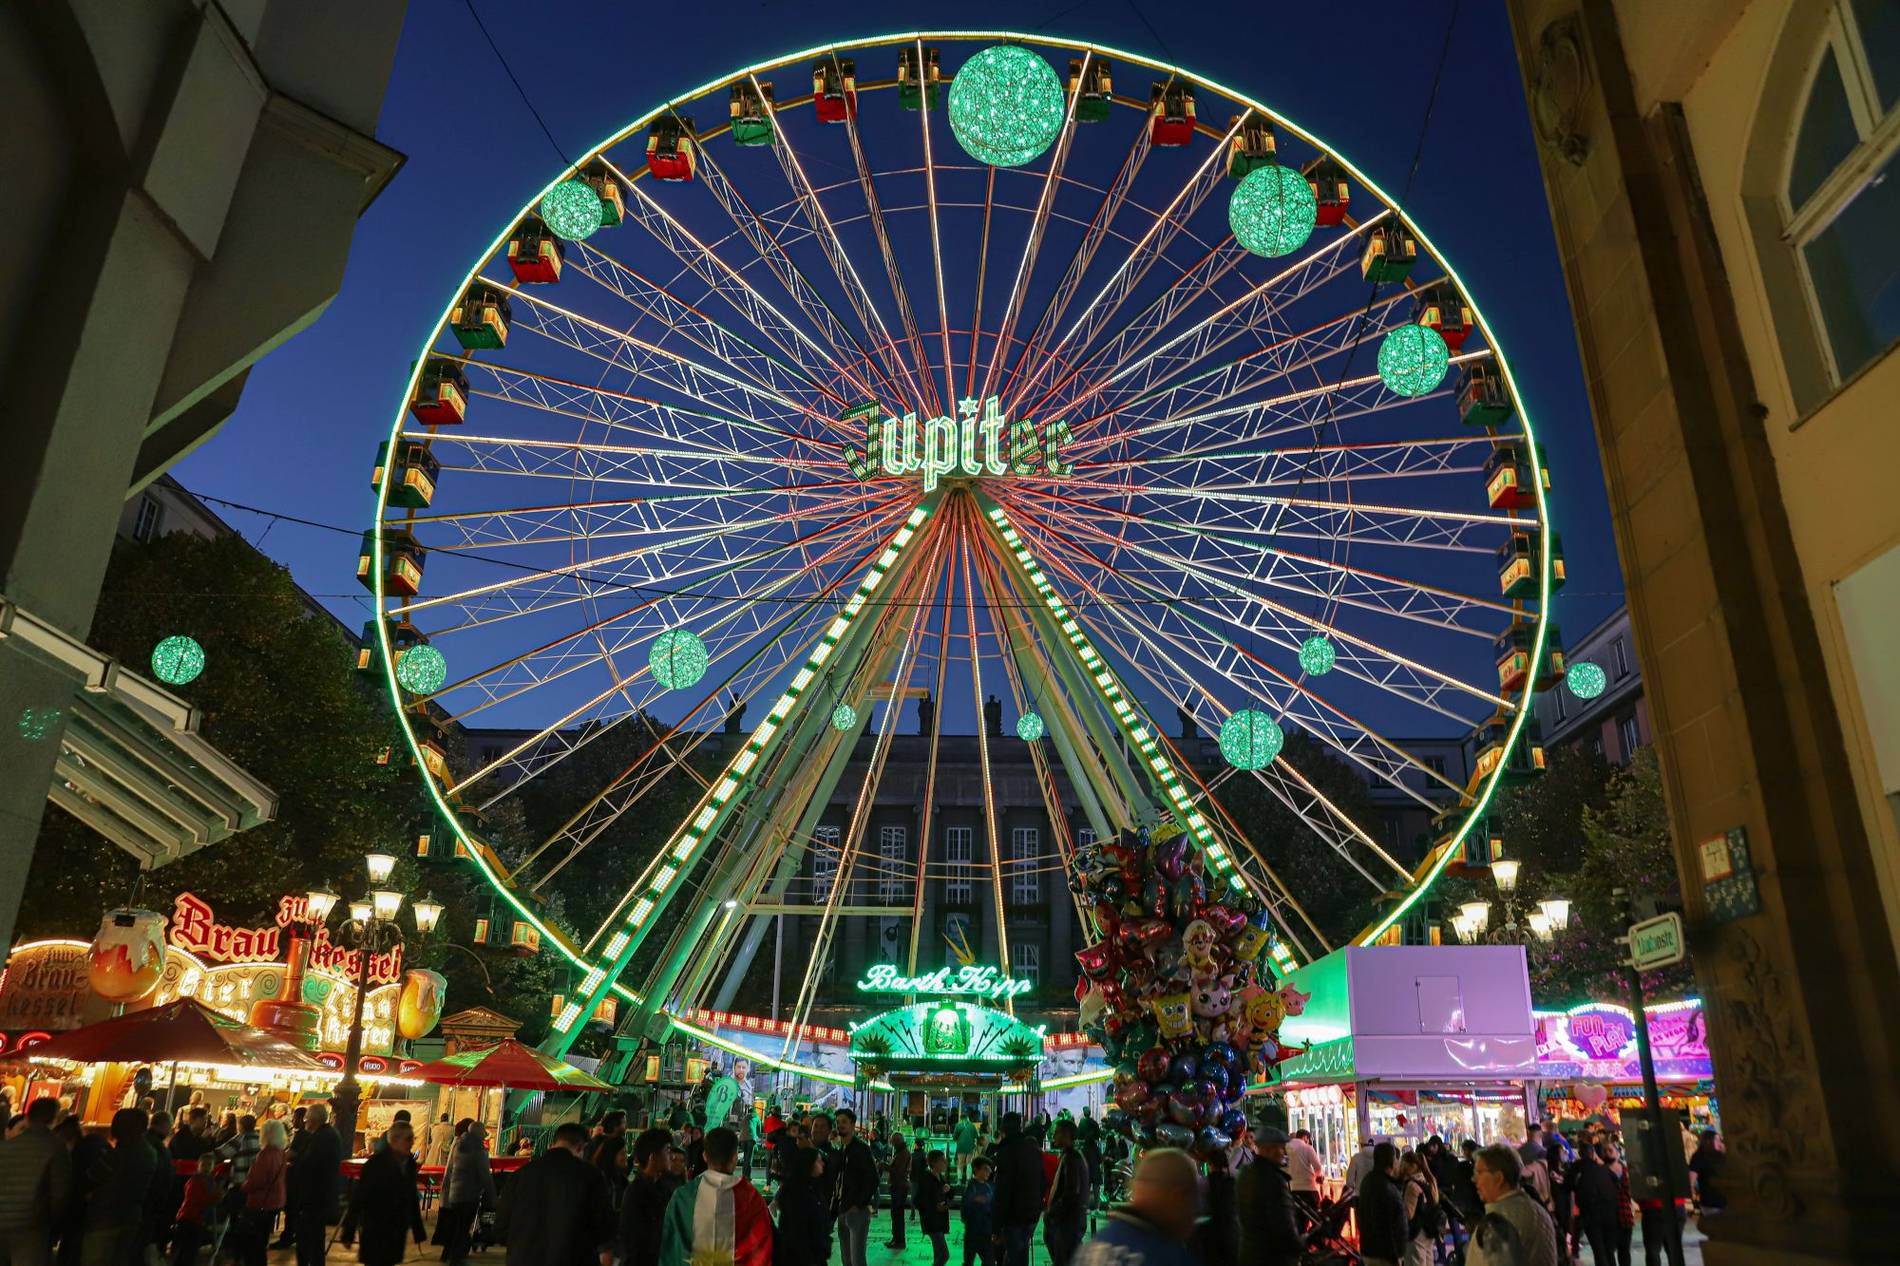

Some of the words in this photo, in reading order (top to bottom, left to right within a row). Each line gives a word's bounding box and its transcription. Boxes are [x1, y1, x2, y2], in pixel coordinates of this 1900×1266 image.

[840, 395, 1076, 492] Jupiter
[170, 892, 280, 962] Brau
[856, 964, 951, 992] Barth
[952, 965, 1032, 999] Kipp
[1571, 1014, 1606, 1037] FUN
[1588, 1022, 1629, 1057] PLAY
